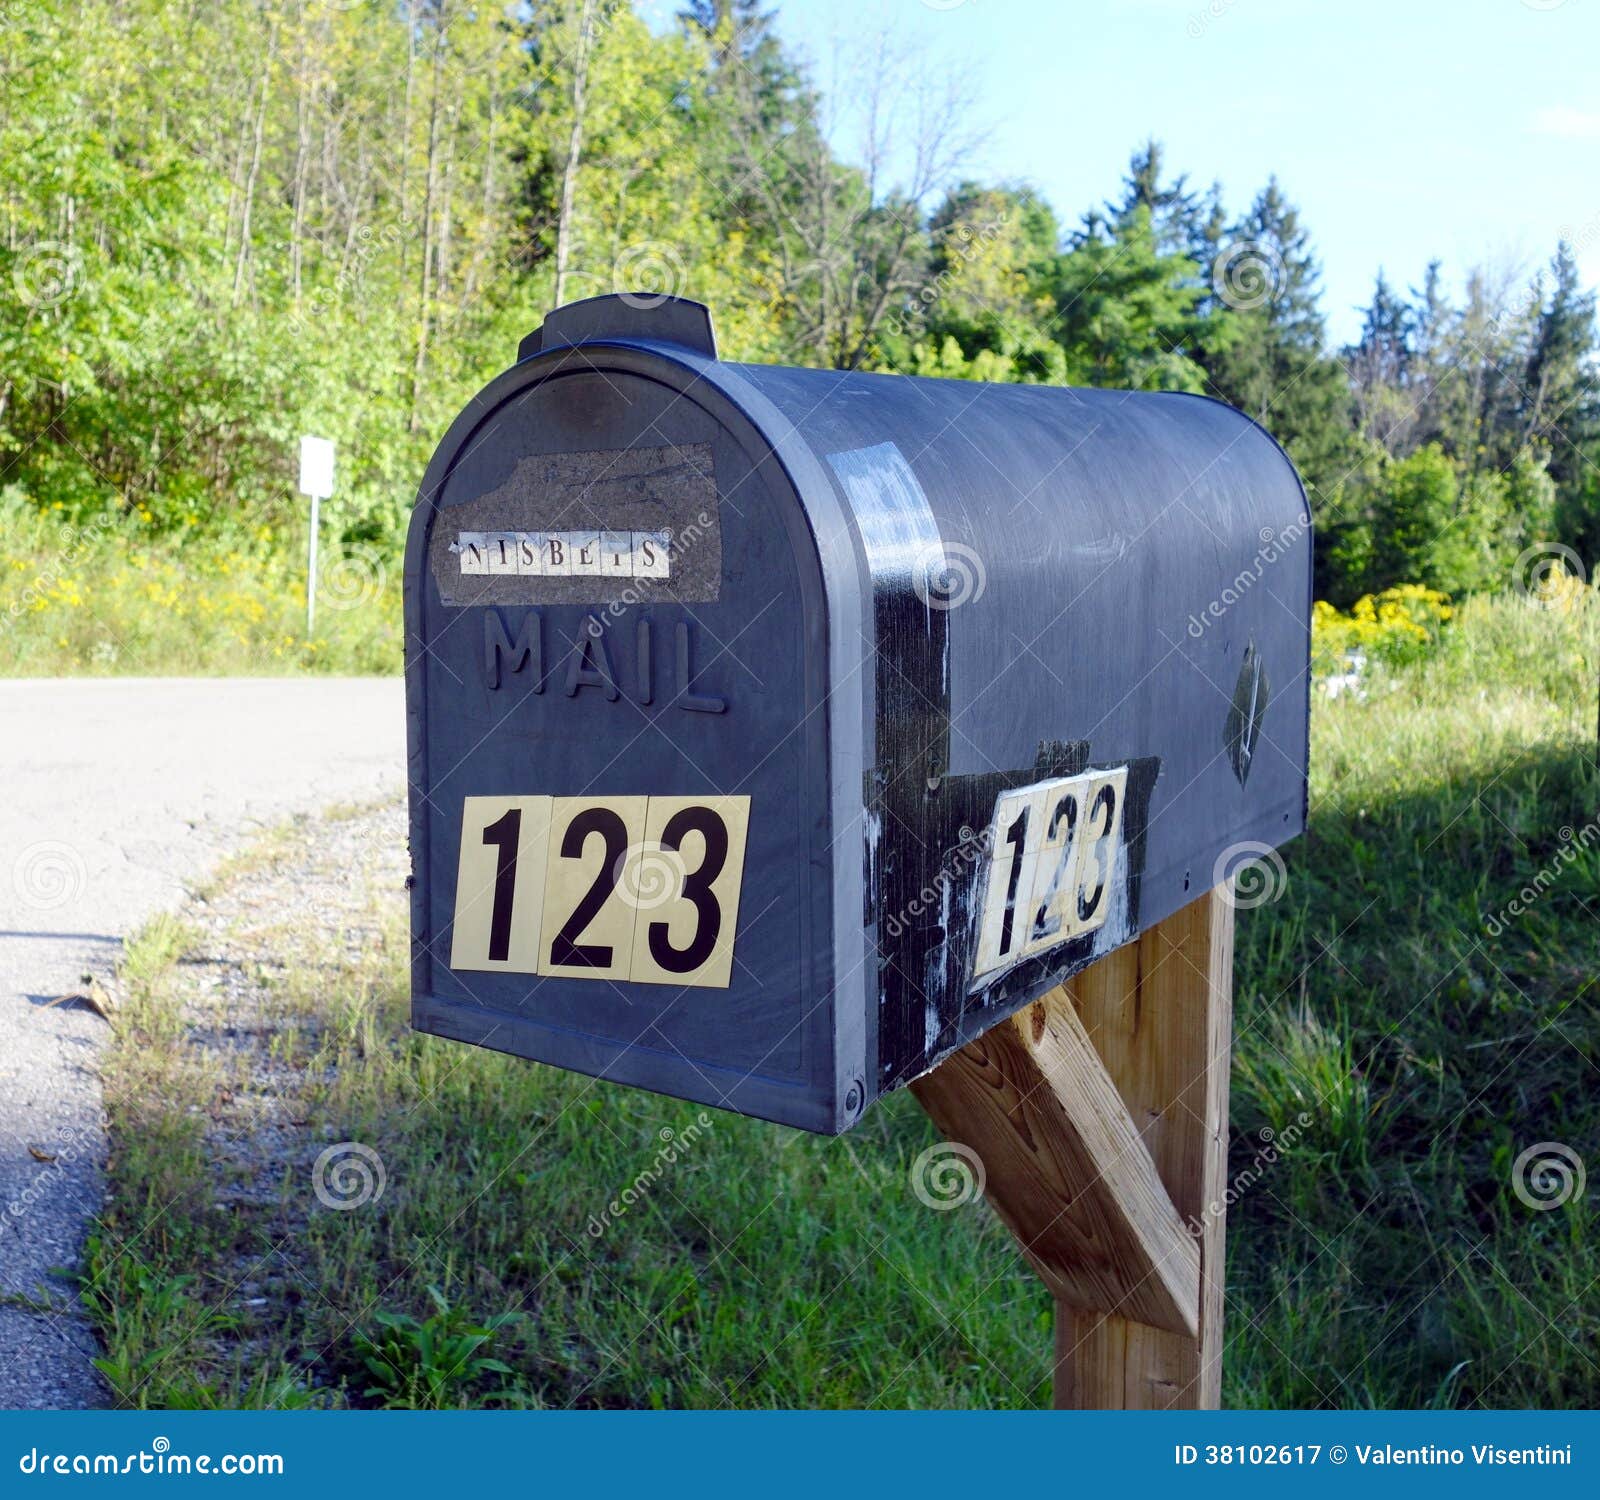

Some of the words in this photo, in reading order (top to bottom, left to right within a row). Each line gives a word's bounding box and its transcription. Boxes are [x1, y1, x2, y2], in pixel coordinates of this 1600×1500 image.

[484, 607, 726, 713] MAIL
[482, 806, 728, 973] 123
[1000, 784, 1115, 956] 123
